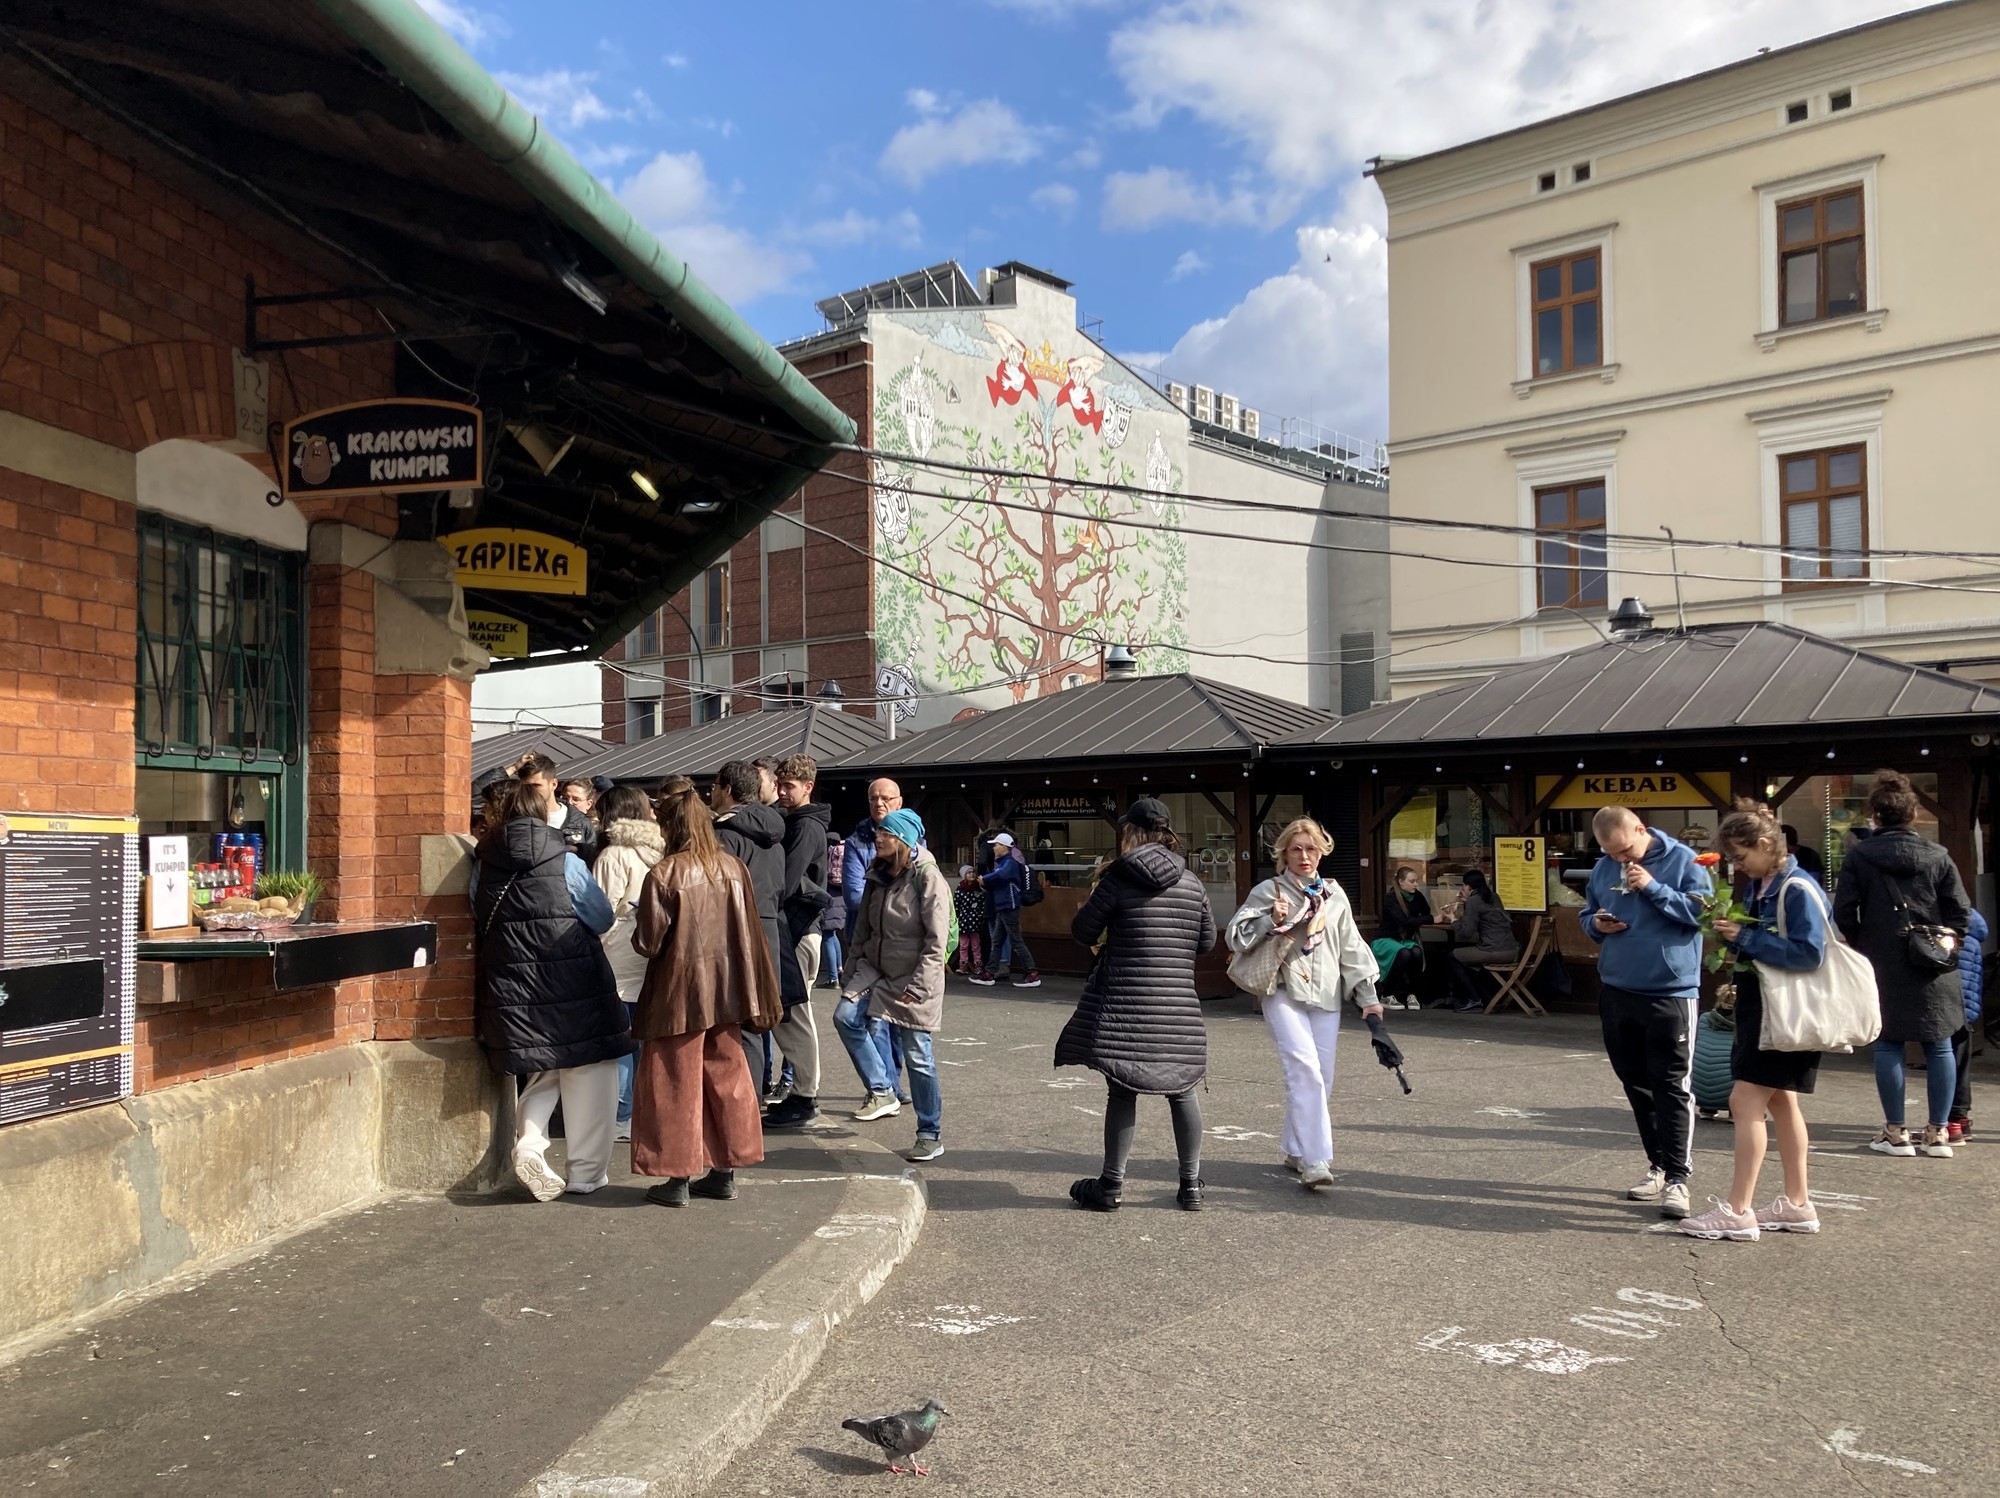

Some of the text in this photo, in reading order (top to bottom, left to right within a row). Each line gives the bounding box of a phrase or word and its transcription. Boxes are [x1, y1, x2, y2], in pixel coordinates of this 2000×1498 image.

[240, 408, 263, 434] 25
[347, 425, 474, 455] KRAKOWSKI
[370, 454, 449, 481] KUMPIR
[455, 541, 569, 577] ZAPIEXA
[469, 632, 505, 642] KANKI
[1584, 776, 1677, 793] KEBAB
[1021, 799, 1050, 808] SHAM
[48, 821, 69, 830] MENU
[163, 844, 177, 855] IT'S
[1524, 839, 1536, 861] 8
[155, 861, 186, 873] KUMPIR
